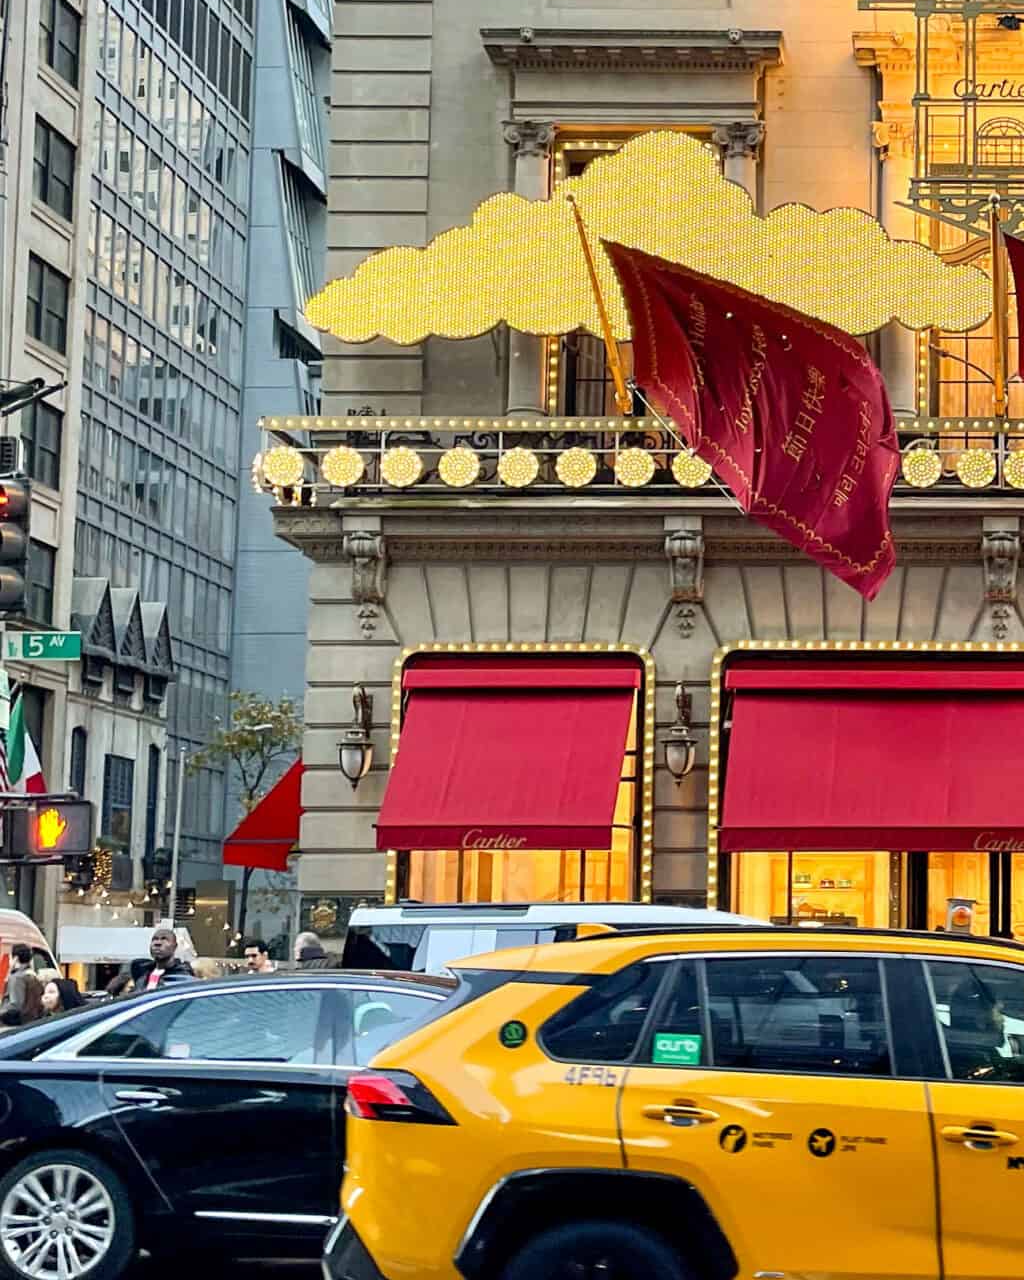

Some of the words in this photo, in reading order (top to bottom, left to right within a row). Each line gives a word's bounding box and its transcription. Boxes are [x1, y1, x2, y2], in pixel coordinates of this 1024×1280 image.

[28, 635, 44, 657] 5
[49, 635, 66, 647] AV
[462, 828, 528, 849] Cartier
